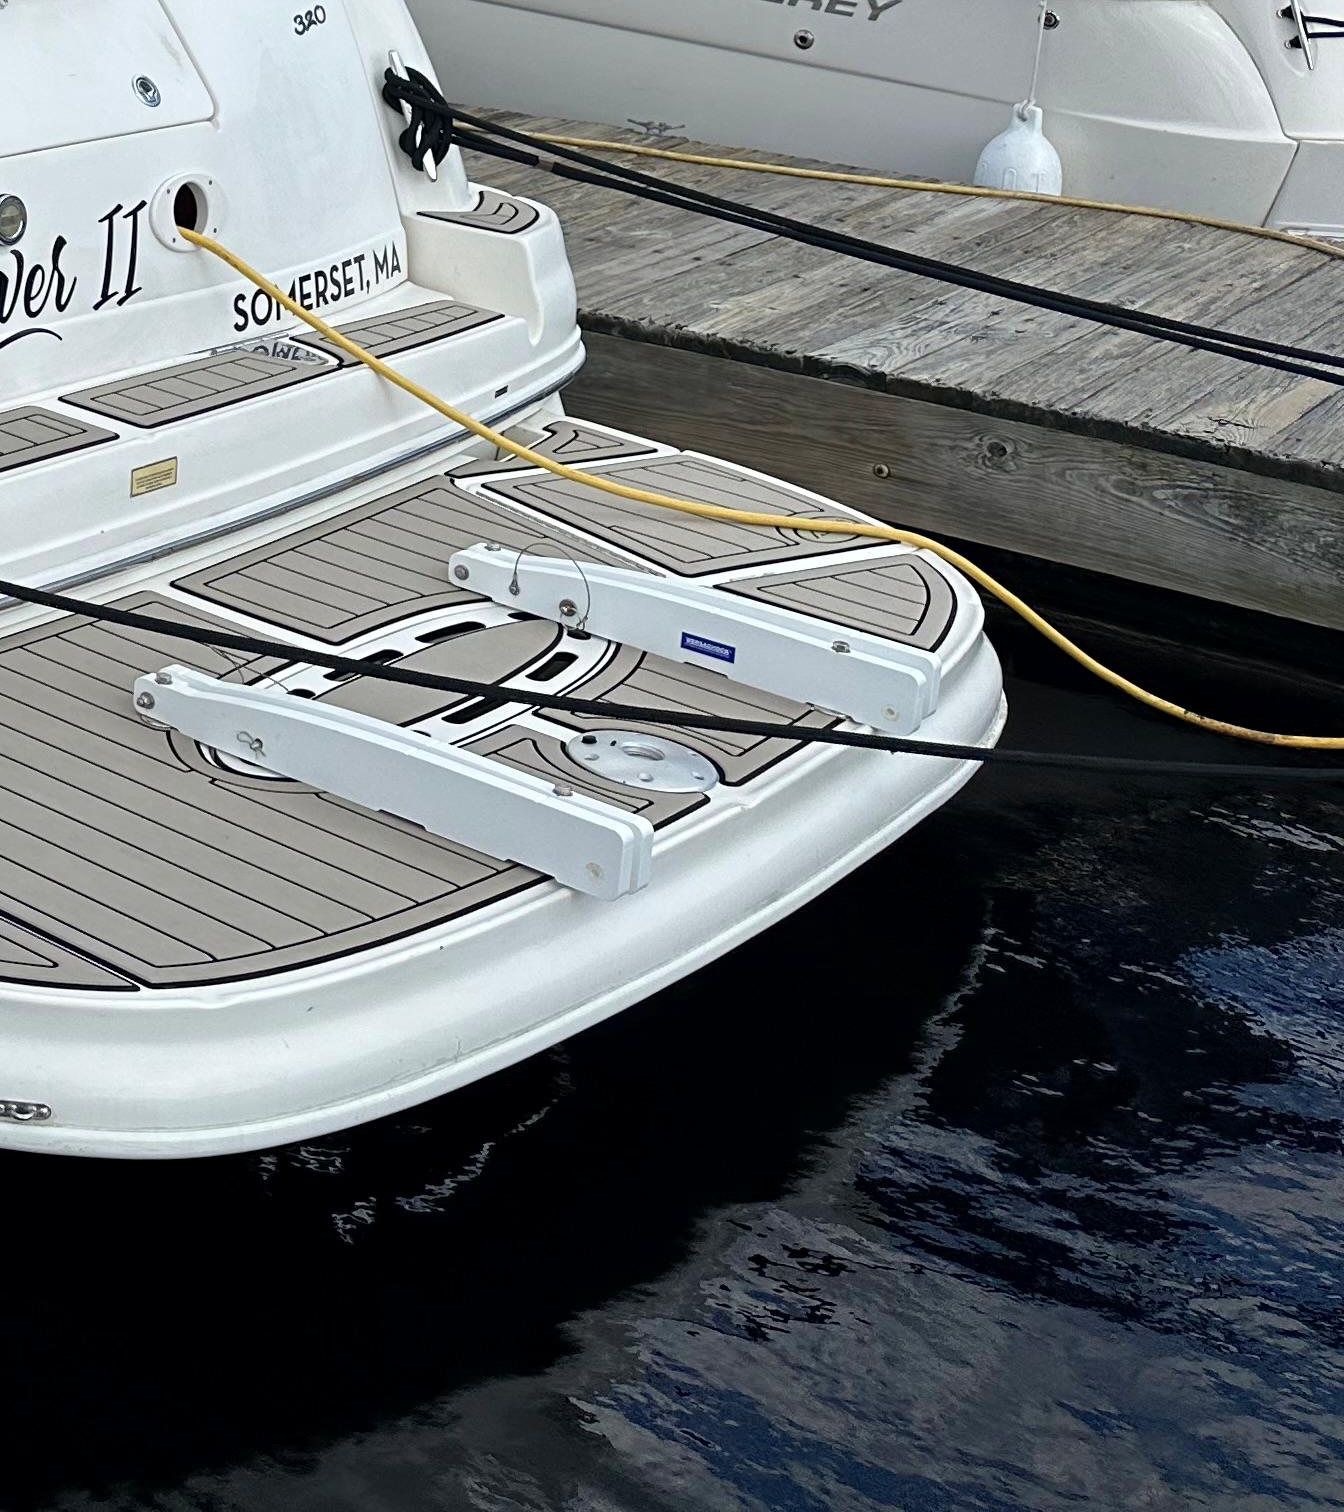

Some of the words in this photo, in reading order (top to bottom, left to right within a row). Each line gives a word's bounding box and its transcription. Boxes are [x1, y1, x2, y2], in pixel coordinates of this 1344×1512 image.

[293, 4, 327, 36] 320
[93, 199, 149, 312] II
[373, 239, 403, 285] MA
